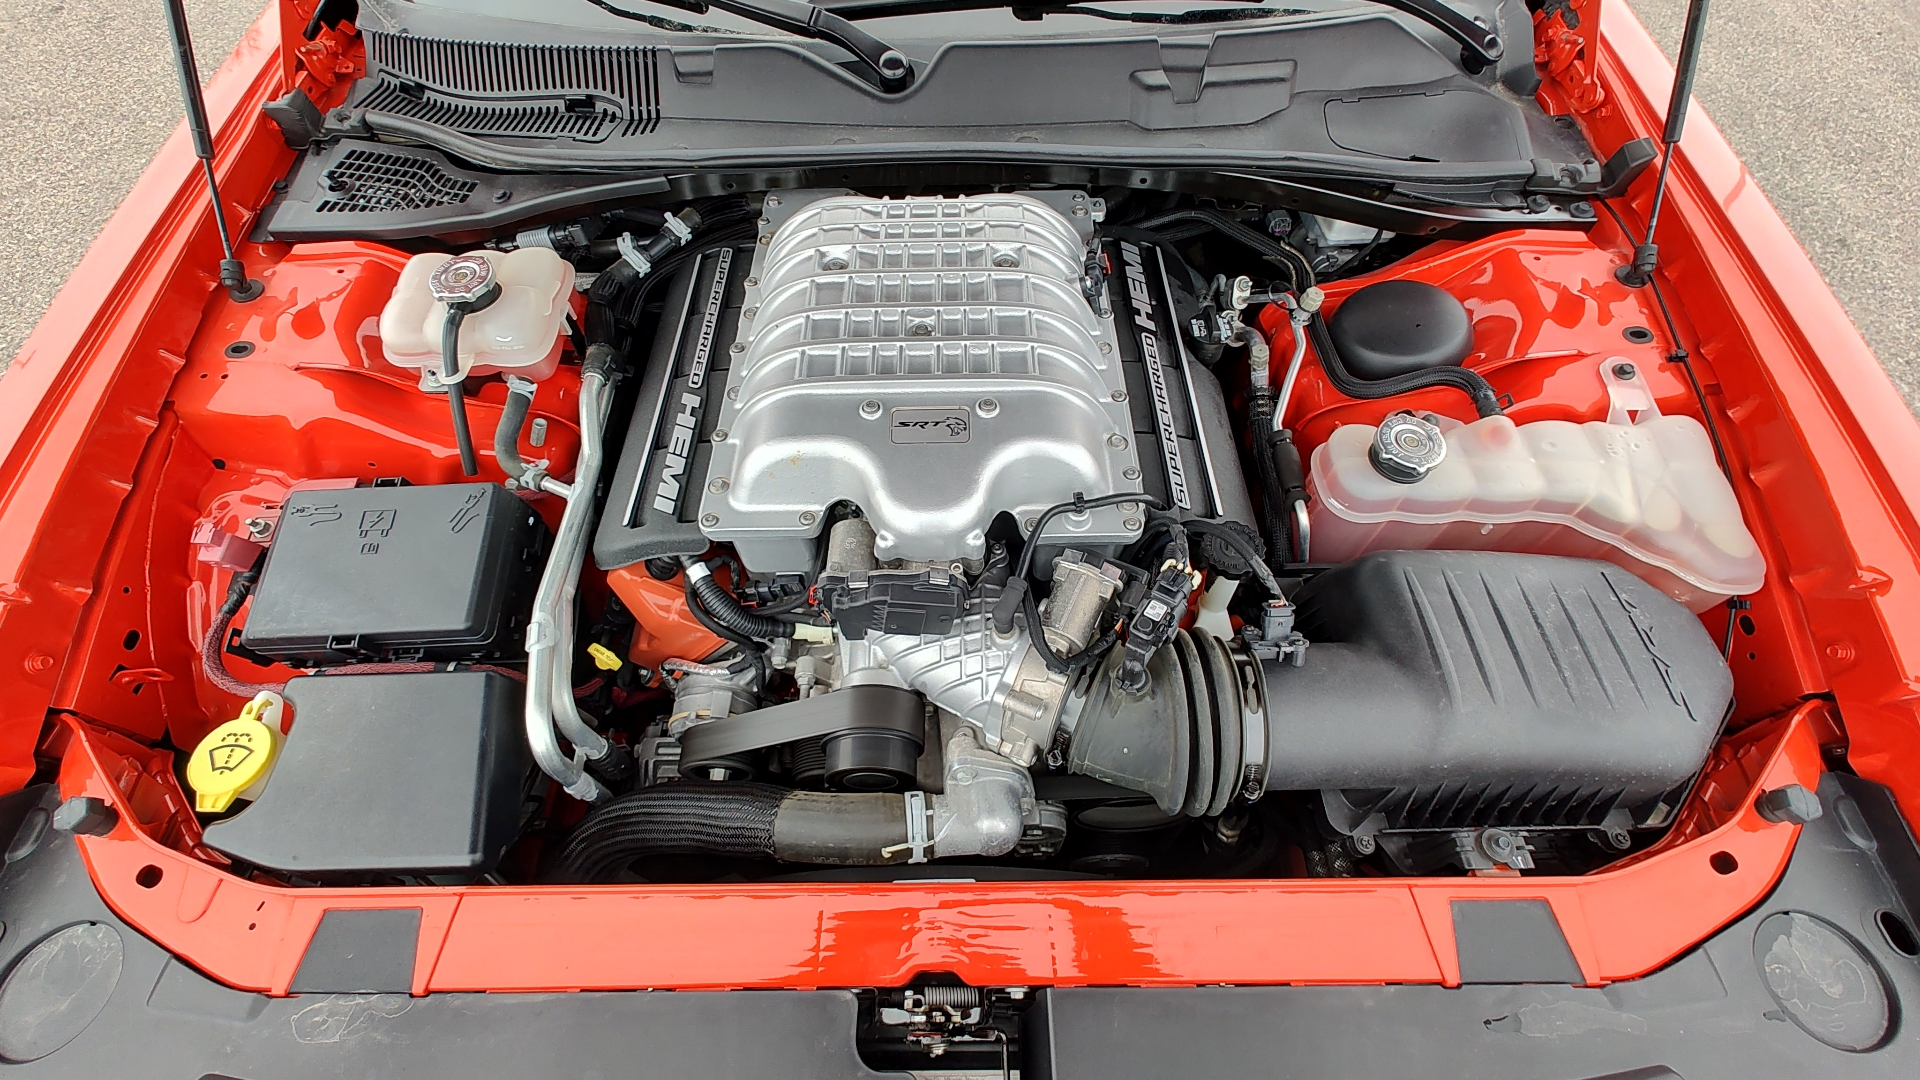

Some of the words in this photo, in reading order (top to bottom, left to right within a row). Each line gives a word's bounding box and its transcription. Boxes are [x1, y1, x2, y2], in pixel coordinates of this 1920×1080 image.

[690, 249, 732, 387] SUPERCHARGED
[1120, 241, 1156, 332] HEMI
[653, 392, 702, 515] HEMI
[893, 421, 947, 430] SRT
[1142, 334, 1190, 508] SUPERCHARGED
